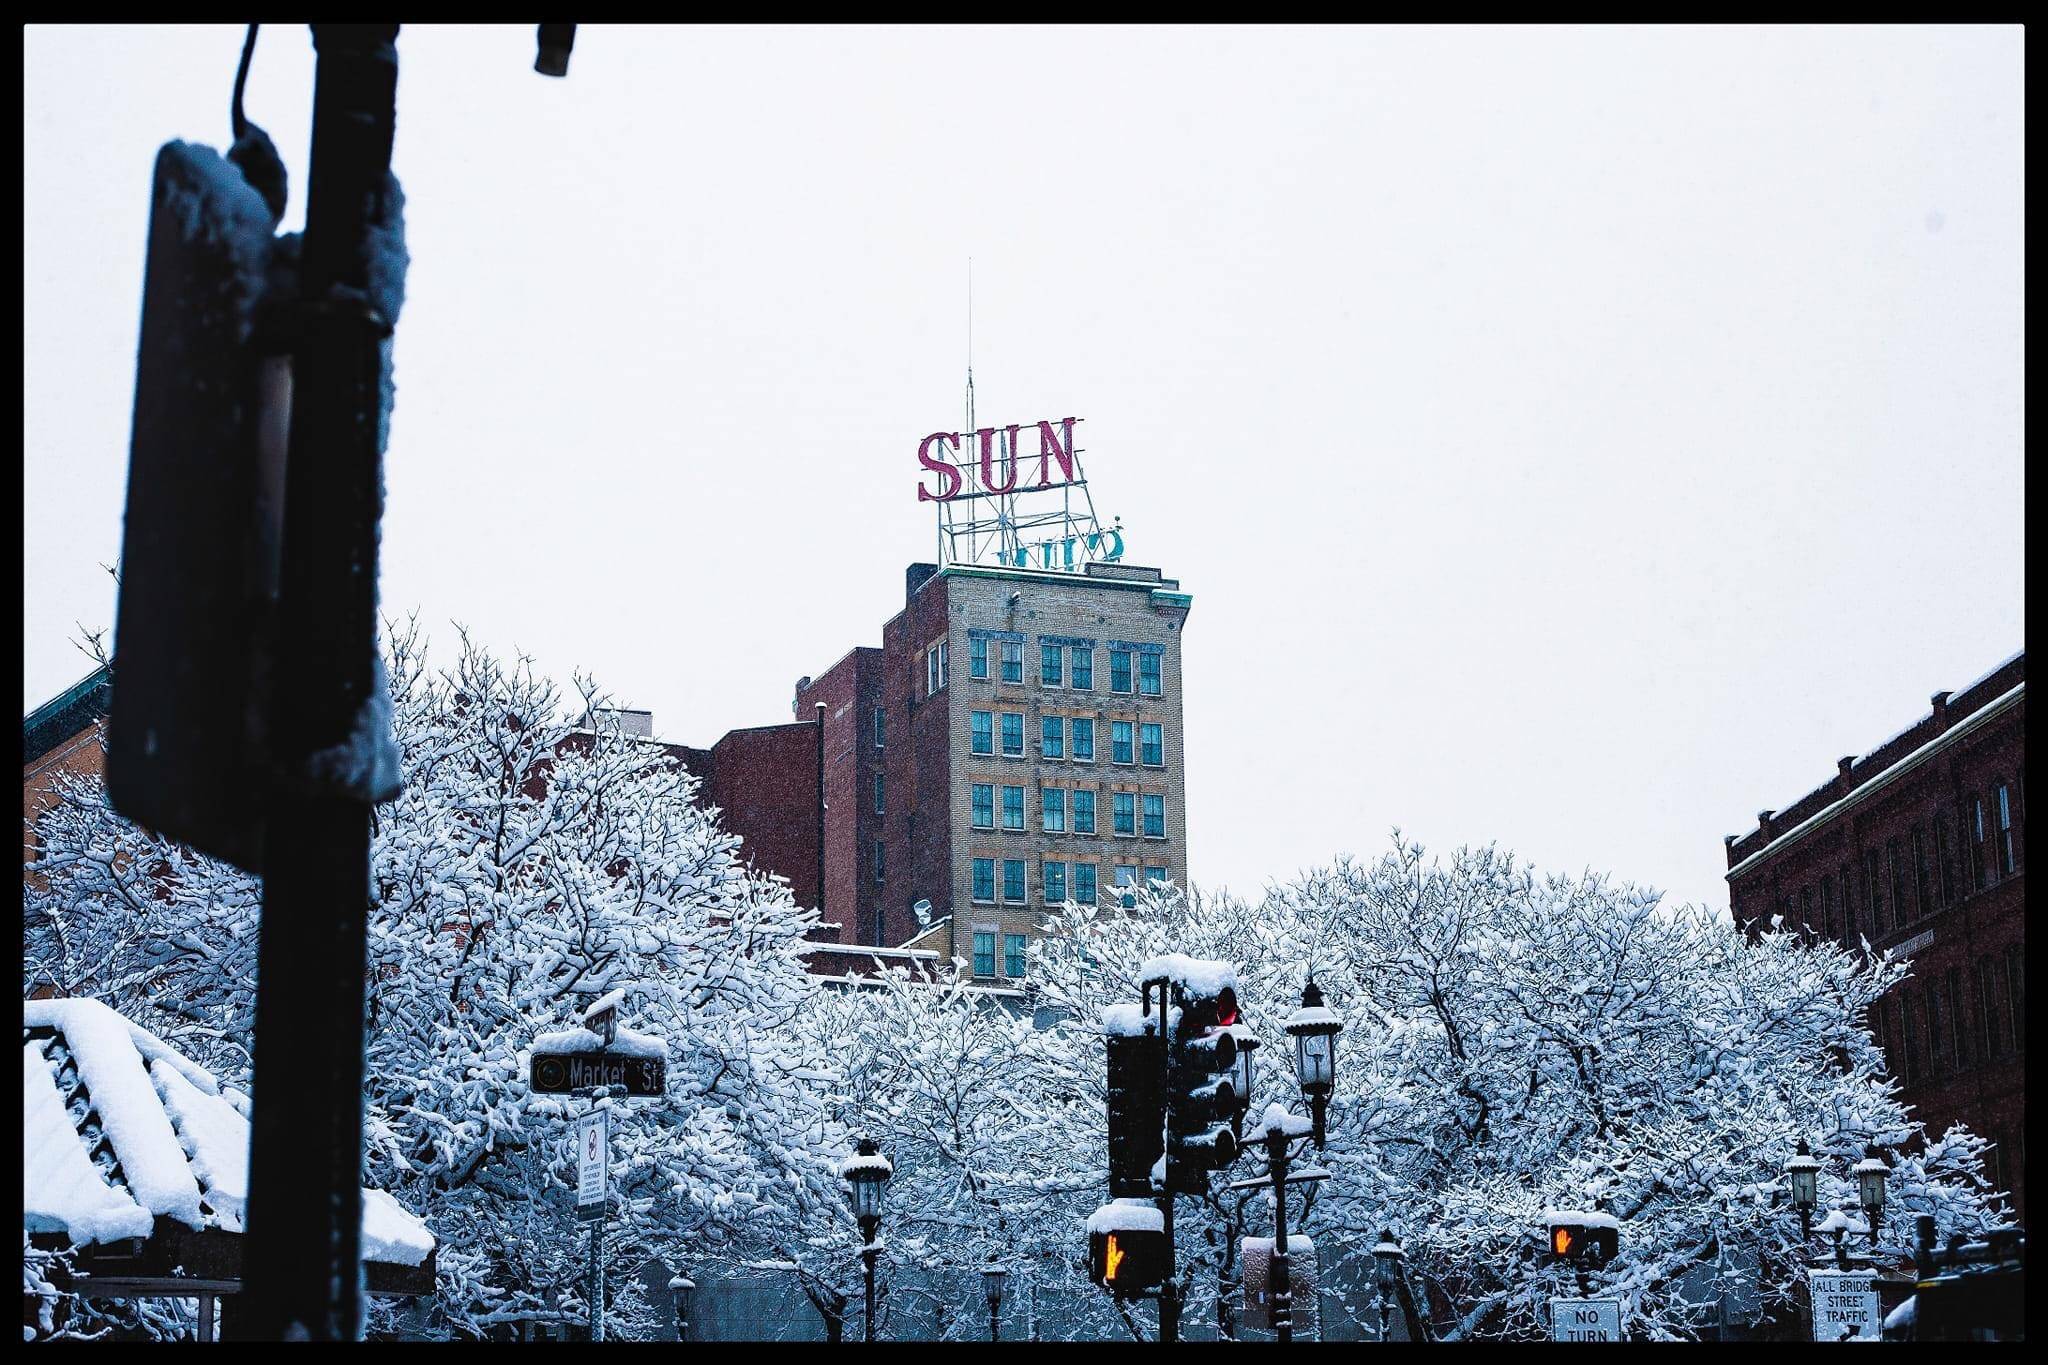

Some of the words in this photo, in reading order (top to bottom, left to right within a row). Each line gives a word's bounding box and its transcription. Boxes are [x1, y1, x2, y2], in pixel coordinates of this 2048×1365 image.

[918, 417, 1076, 502] SUN
[570, 1058, 626, 1087] Market
[642, 1062, 658, 1092] St
[1816, 1281, 1835, 1293] ALL
[1828, 1295, 1865, 1308] STREET
[1575, 1310, 1599, 1325] NO
[1826, 1310, 1869, 1323] TRAFFIC
[1568, 1330, 1608, 1342] TURN
